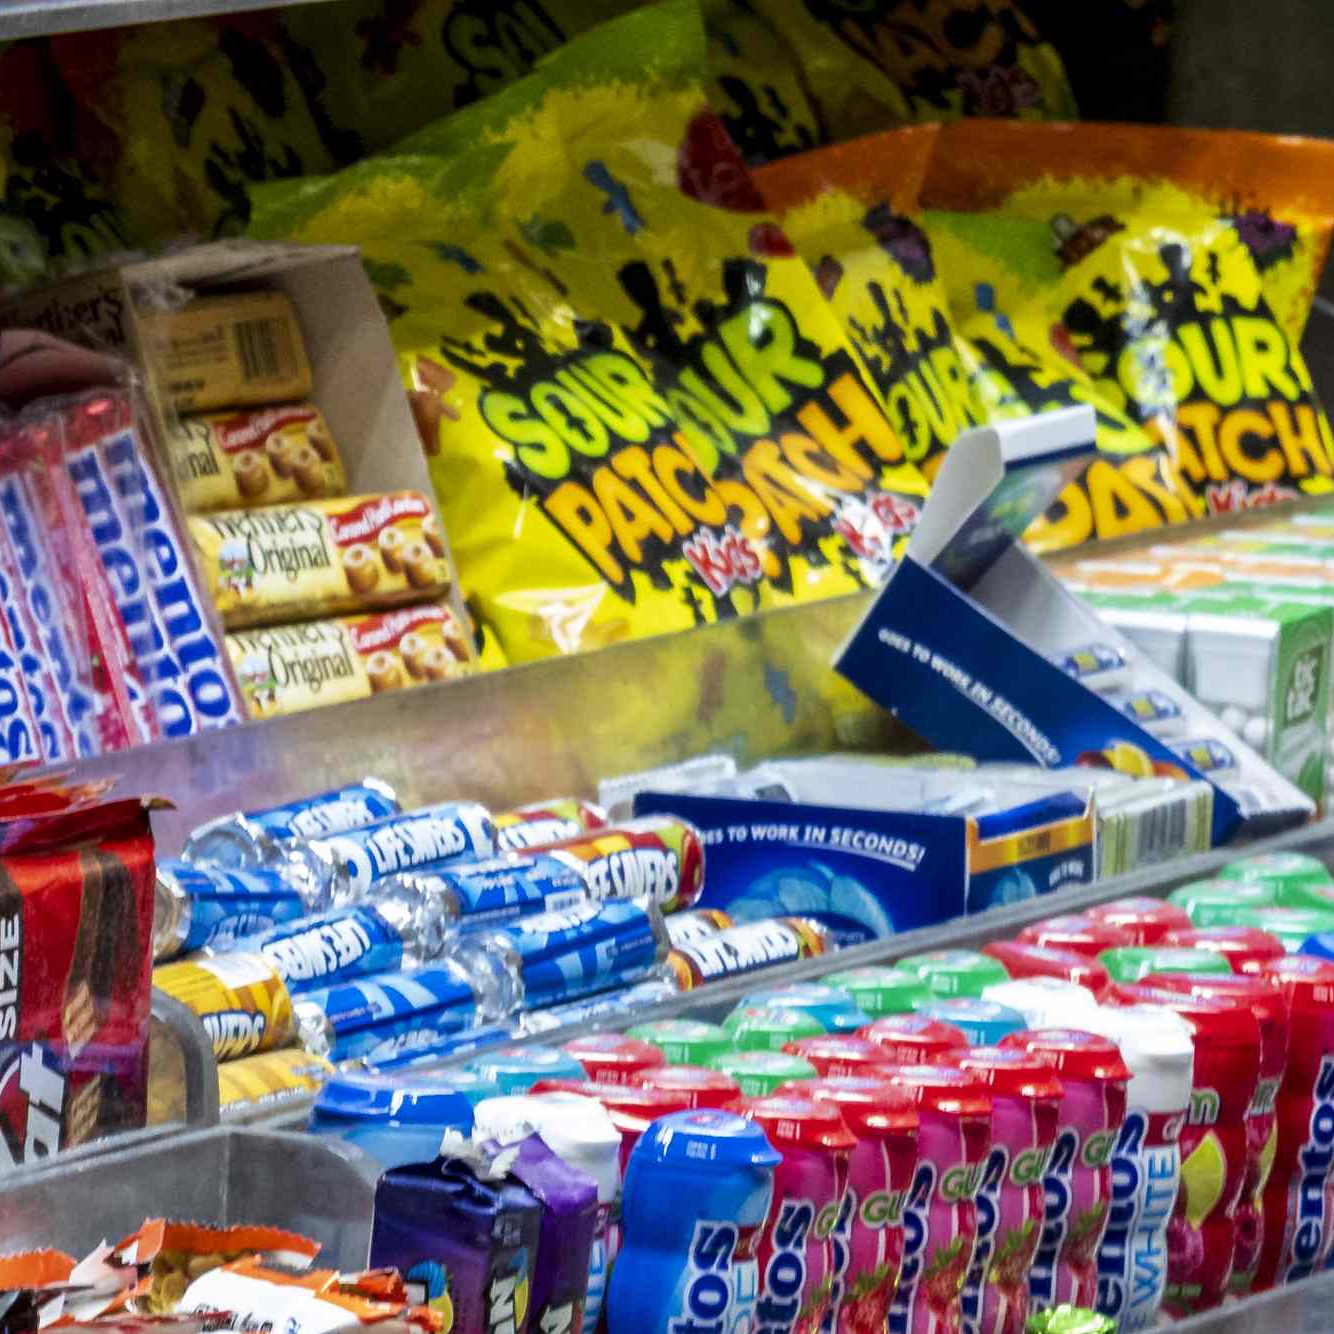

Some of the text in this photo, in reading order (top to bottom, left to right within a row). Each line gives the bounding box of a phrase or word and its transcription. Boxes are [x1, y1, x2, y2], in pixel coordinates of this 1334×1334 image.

[1119, 316, 1301, 407] OUR
[477, 352, 674, 479] SOUR
[543, 431, 725, 588] PATC
[105, 431, 244, 726] mento
[246, 533, 332, 583] Original
[685, 524, 764, 597] Kids
[267, 644, 355, 693] Original
[727, 825, 748, 843] TO
[750, 824, 800, 843] WORK
[803, 824, 825, 844] IN
[829, 826, 927, 865] SECONDS!
[941, 1165, 983, 1202] GU
[1010, 1147, 1049, 1187] GU
[860, 1192, 905, 1228] GU
